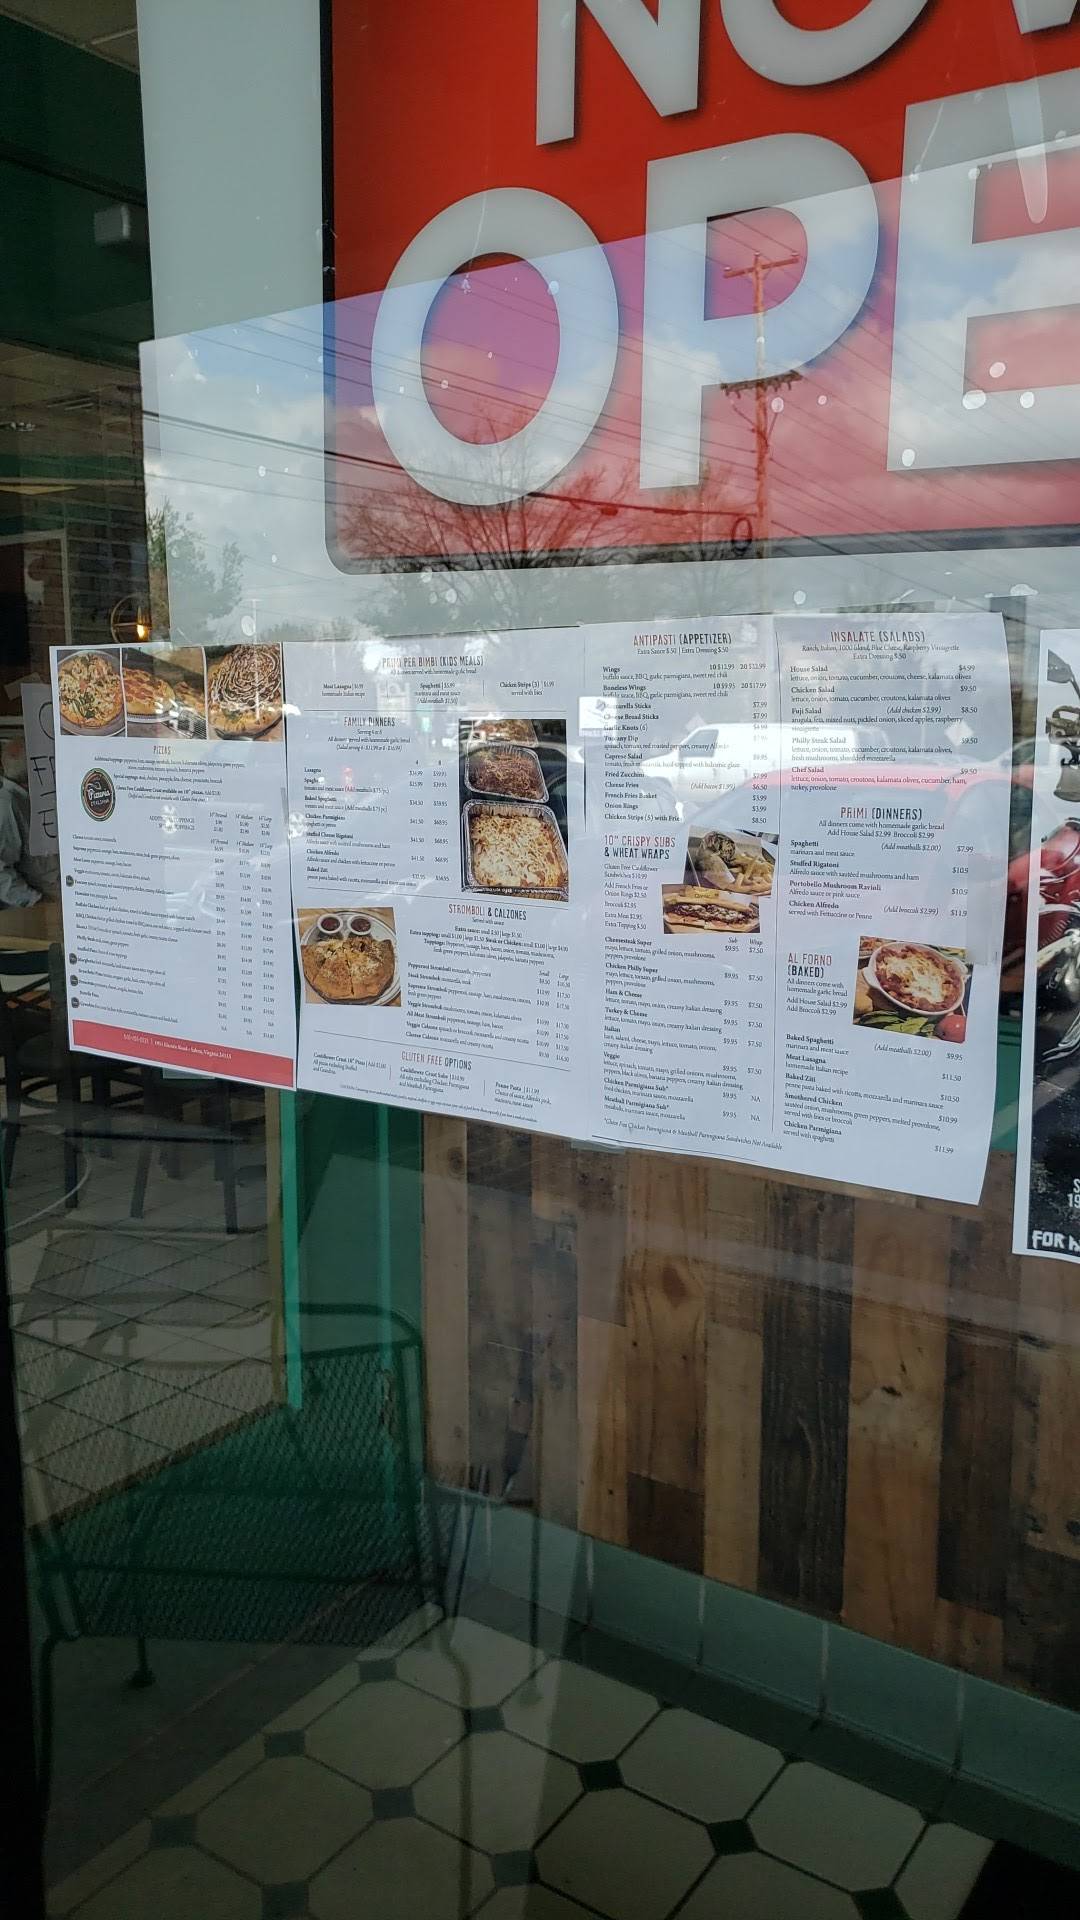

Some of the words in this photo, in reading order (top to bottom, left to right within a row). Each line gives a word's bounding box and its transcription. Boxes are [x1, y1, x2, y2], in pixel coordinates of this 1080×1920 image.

[634, 634, 676, 646] ANTIPASTI
[679, 633, 732, 644] (APPETIZER)
[831, 631, 875, 642] INSALATE
[878, 631, 925, 642] (SALADS)
[460, 655, 483, 666] MEALS)
[344, 717, 366, 726] FAMILY
[368, 717, 395, 727] DINNERS
[153, 746, 171, 755] PIZZAS
[840, 807, 867, 819] PRIMI
[872, 808, 922, 820] (DINNERS)
[622, 836, 650, 846] CRISPY
[655, 837, 675, 847] SUBS
[791, 840, 819, 849] Spaghetti
[604, 847, 610, 857] &
[613, 848, 638, 858] WHEAT
[641, 849, 669, 859] WRAPS
[813, 861, 839, 869] Rigatoni
[790, 880, 822, 888] Portobello
[789, 900, 814, 908] Chicken
[448, 904, 485, 916] STROMBOLI
[487, 907, 492, 916] &
[494, 908, 527, 920] CALZONES
[788, 953, 798, 963] AL
[802, 954, 832, 965] FORNO
[788, 964, 824, 978] (BAKED)
[605, 1007, 622, 1015] Turkey
[786, 1034, 804, 1042] Baked
[806, 1036, 834, 1045] Spaghetti
[401, 1051, 425, 1064] GLUTEN
[427, 1054, 442, 1066] FREE
[445, 1056, 472, 1070] OPTIONS
[801, 1055, 826, 1064] Lasagna
[785, 1092, 816, 1103] Smothered
[818, 1098, 843, 1107] Chicken
[784, 1120, 807, 1130] Chicken
[808, 1125, 842, 1135] Parmigiana
[1032, 1230, 1065, 1249] FOR
